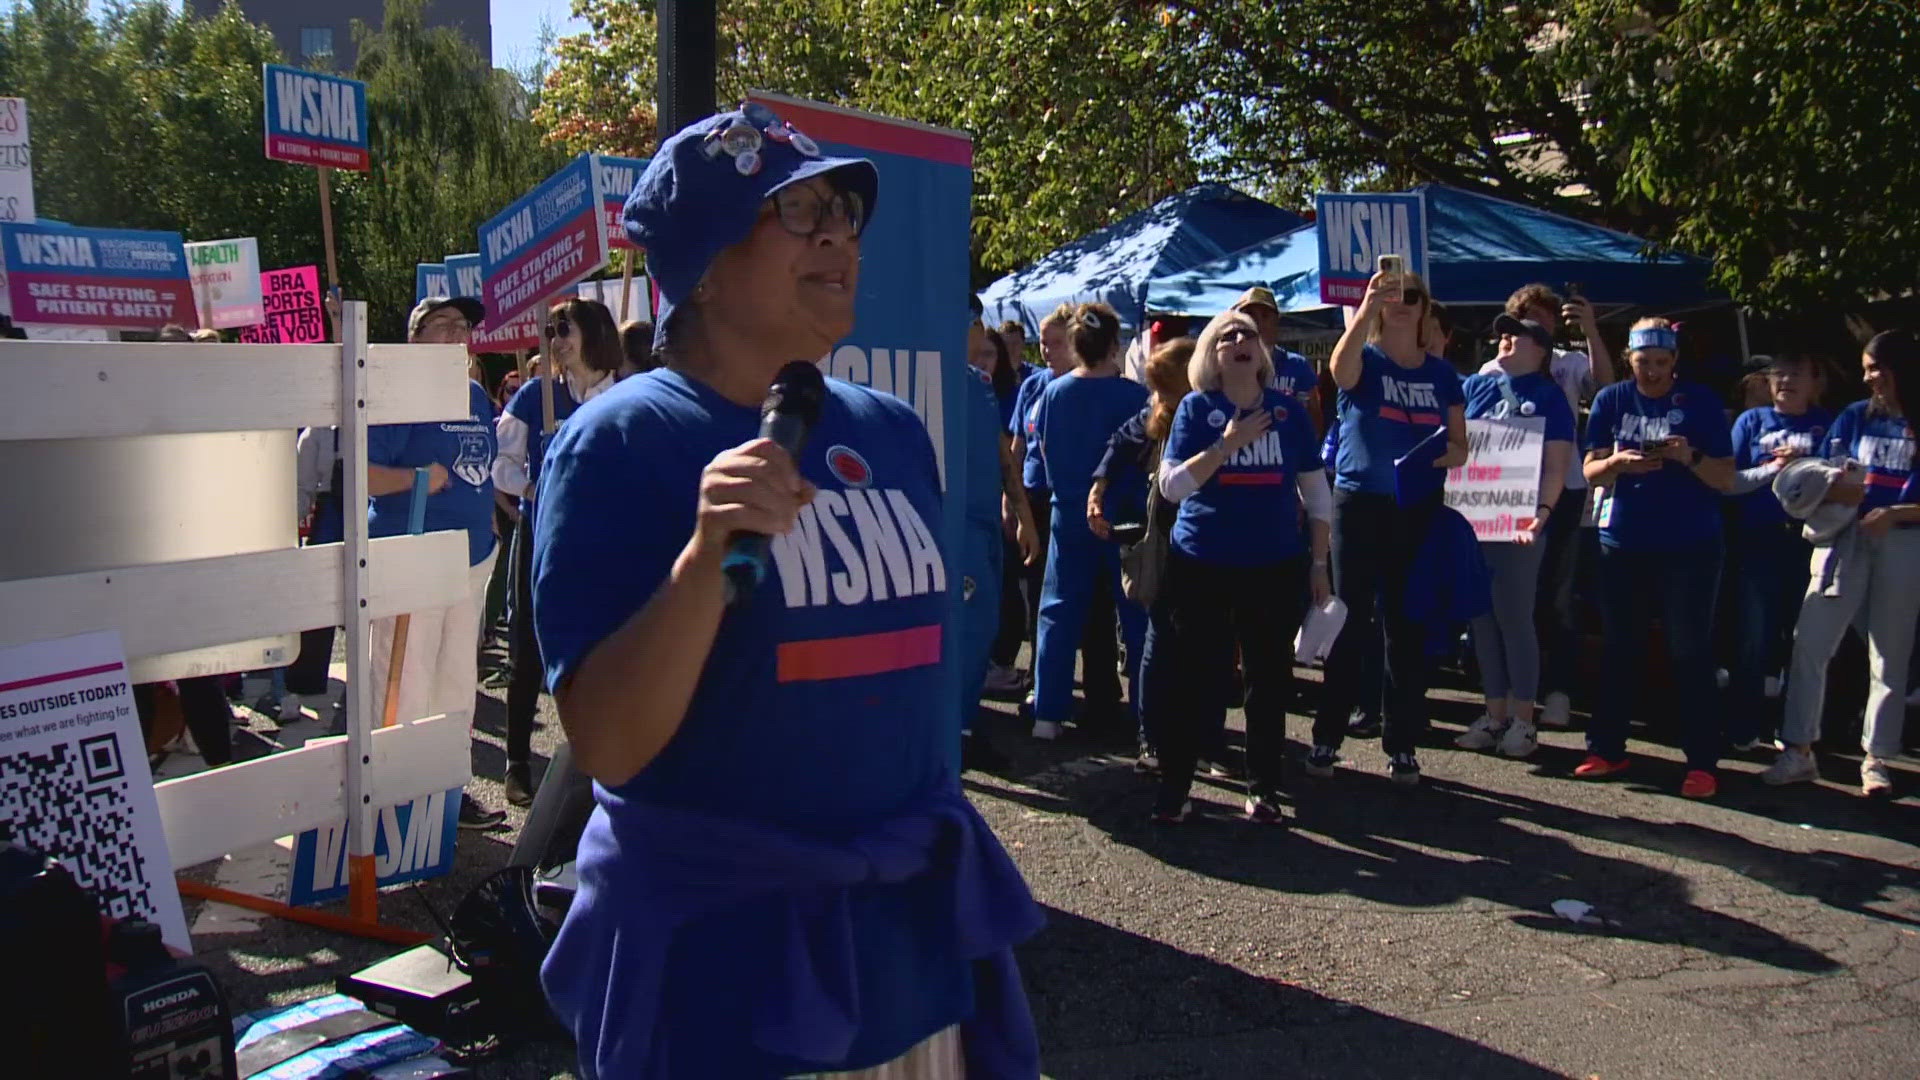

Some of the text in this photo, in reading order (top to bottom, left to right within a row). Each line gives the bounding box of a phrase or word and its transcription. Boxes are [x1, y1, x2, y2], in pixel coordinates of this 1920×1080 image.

[275, 71, 359, 142] WSNA
[601, 165, 633, 194] SNA
[486, 205, 535, 265] WSNA
[1324, 200, 1413, 274] WSNA
[15, 232, 96, 268] WSNA
[494, 264, 521, 300] SAFE
[521, 235, 573, 282] STAFFING
[498, 248, 584, 315] PATIENT SAFETY
[28, 282, 73, 299] SAFE
[75, 284, 158, 303] STAFFING
[270, 273, 306, 292] BRA
[35, 298, 174, 319] PATIENT SAFETY
[263, 290, 316, 310] PORTS
[286, 323, 320, 343] YOU
[522, 323, 539, 338] SA
[1304, 341, 1329, 357] ONL
[1467, 461, 1503, 482] these
[771, 488, 946, 609] WSNA
[19, 692, 78, 716] OUTSIDE
[78, 682, 127, 704] TODAY?
[15, 724, 41, 739] what
[42, 722, 58, 733] we
[59, 717, 76, 730] are
[76, 709, 115, 727] fighting
[116, 705, 130, 717] for
[143, 987, 200, 1014] HONDA
